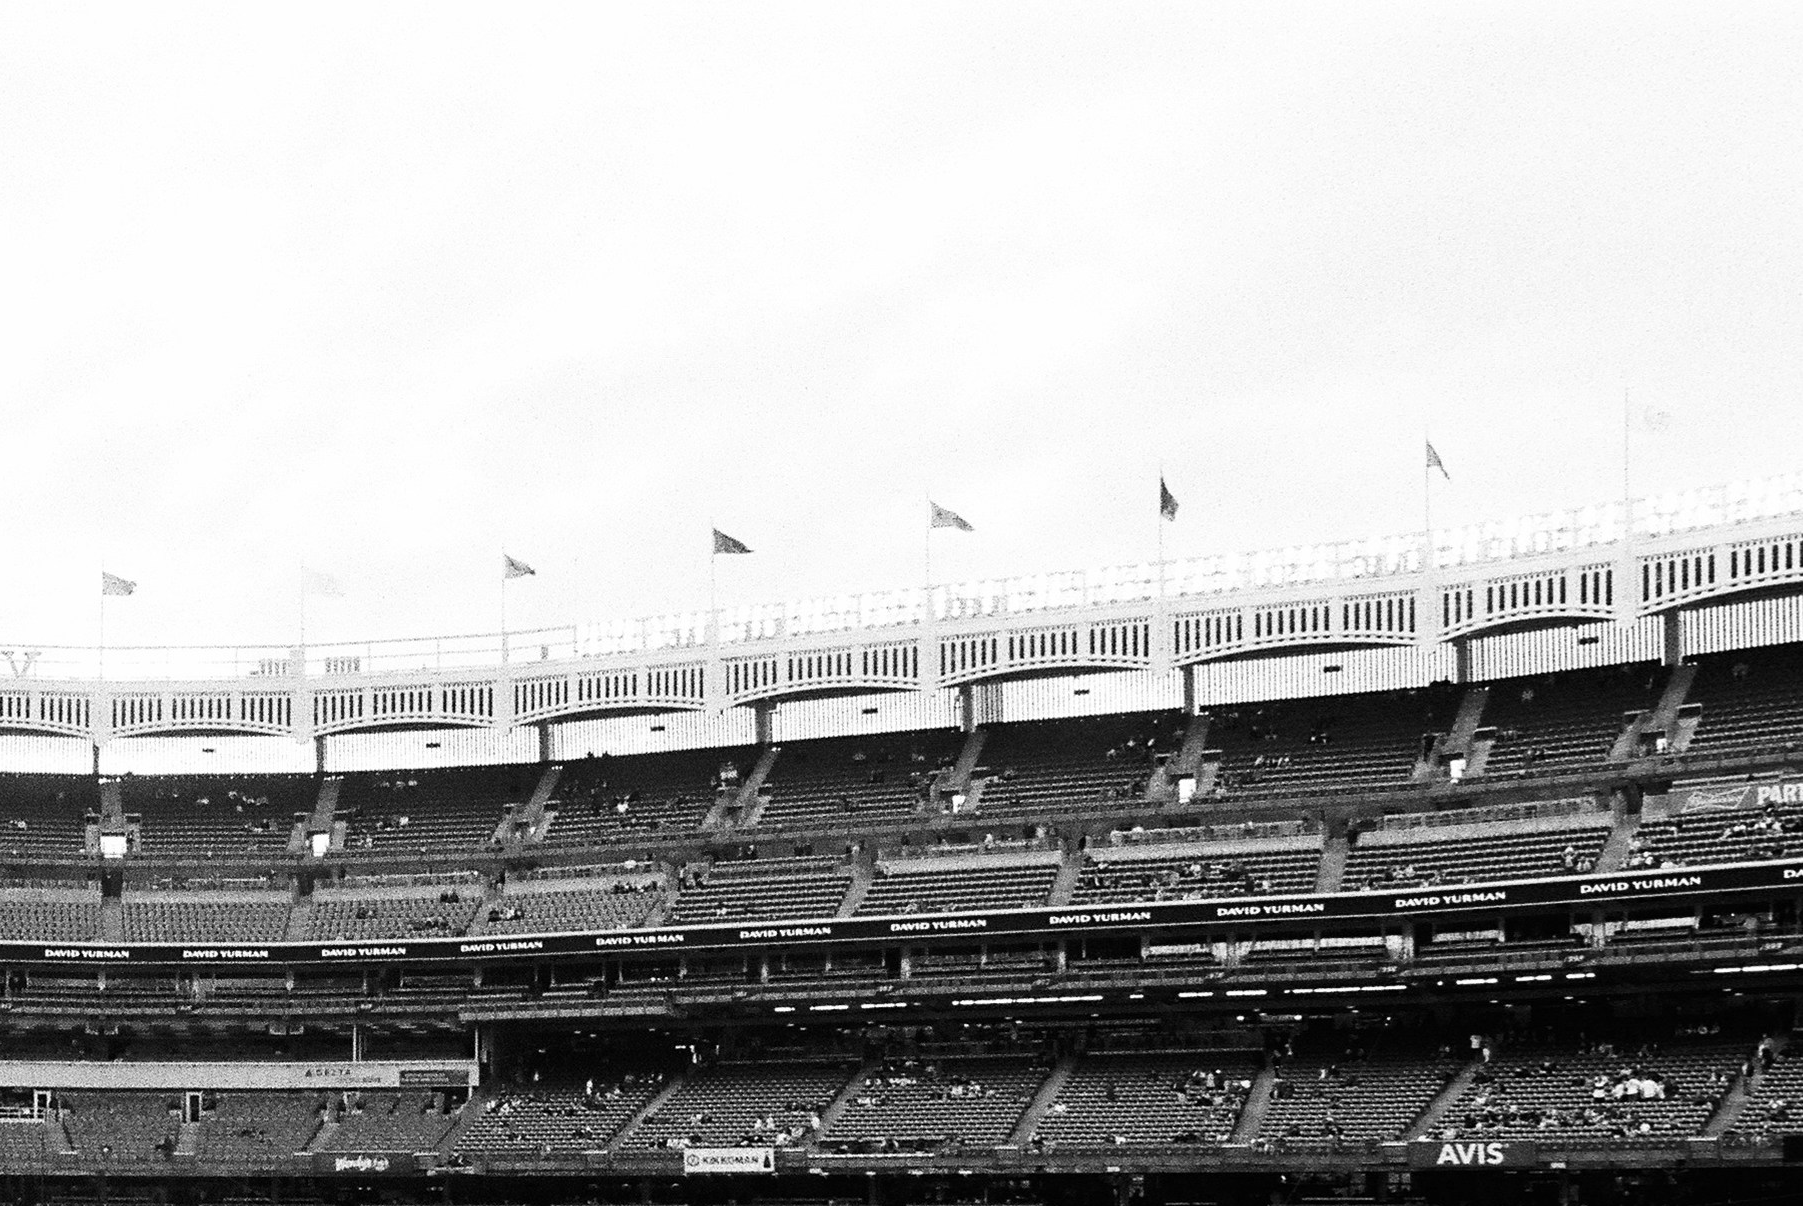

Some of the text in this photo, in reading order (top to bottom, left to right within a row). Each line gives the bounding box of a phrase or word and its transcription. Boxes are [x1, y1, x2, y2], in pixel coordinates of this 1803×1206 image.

[1580, 876, 1702, 894] DAVID YURMAN
[1395, 891, 1506, 908] DAVID YURMAN
[1217, 903, 1325, 917] DAVID YURMAN
[1049, 911, 1151, 925] DAVID YURMAN
[890, 919, 987, 932] DAVID YURMAN
[739, 926, 831, 940] DAVID YURMAN
[596, 934, 685, 946] DAVID YURMAN
[322, 947, 407, 958] DAVID YURMAN
[460, 941, 543, 953] DAVID YURMAN
[44, 949, 130, 959] DAVID YURMAN
[183, 949, 269, 959] DAVID YURMAN
[1436, 1142, 1505, 1165] AVIS
